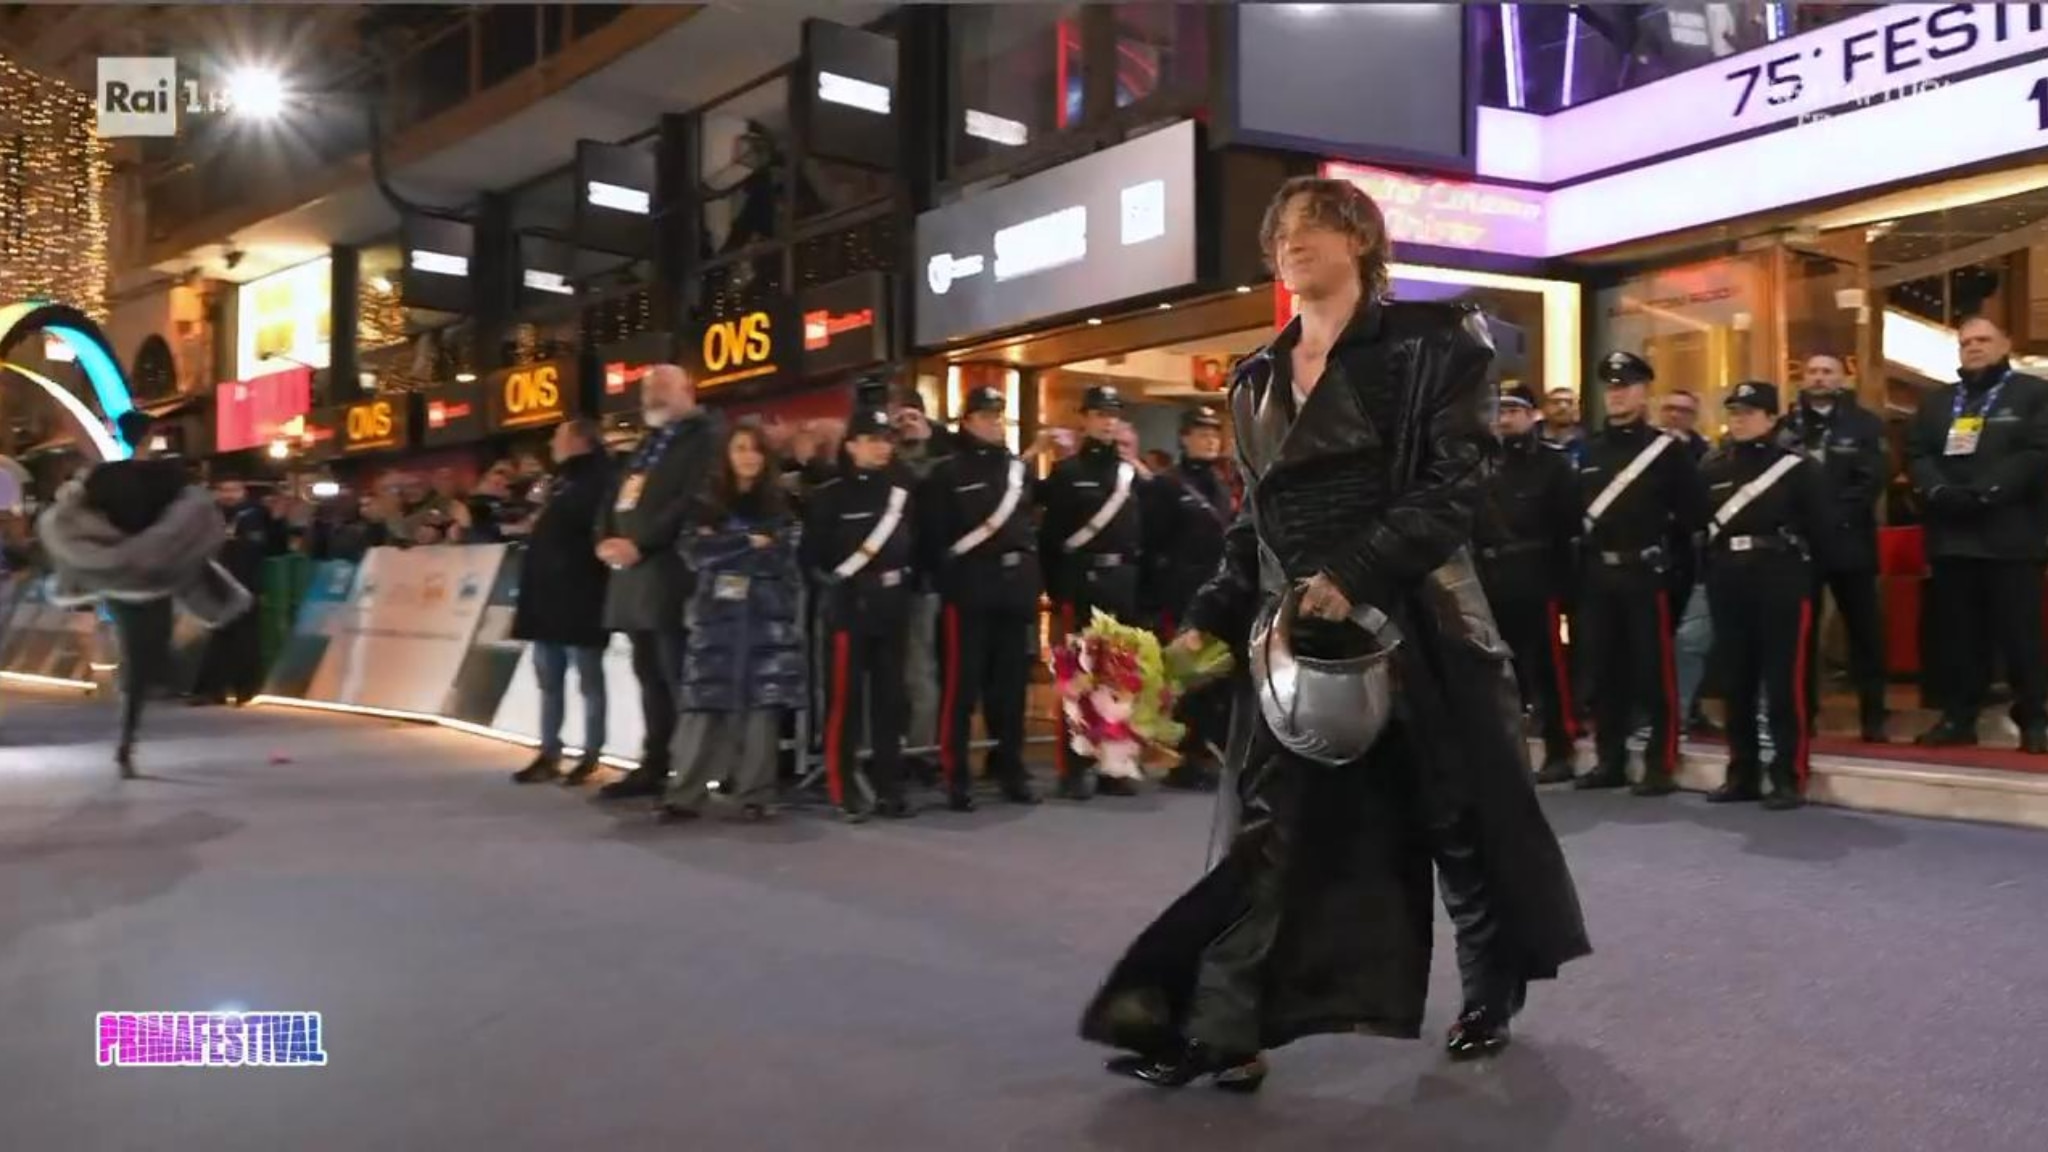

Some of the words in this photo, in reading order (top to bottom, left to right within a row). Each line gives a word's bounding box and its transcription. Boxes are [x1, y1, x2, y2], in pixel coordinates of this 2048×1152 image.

[703, 312, 771, 371] OVS
[504, 366, 559, 413] OVS
[346, 402, 392, 440] OVS
